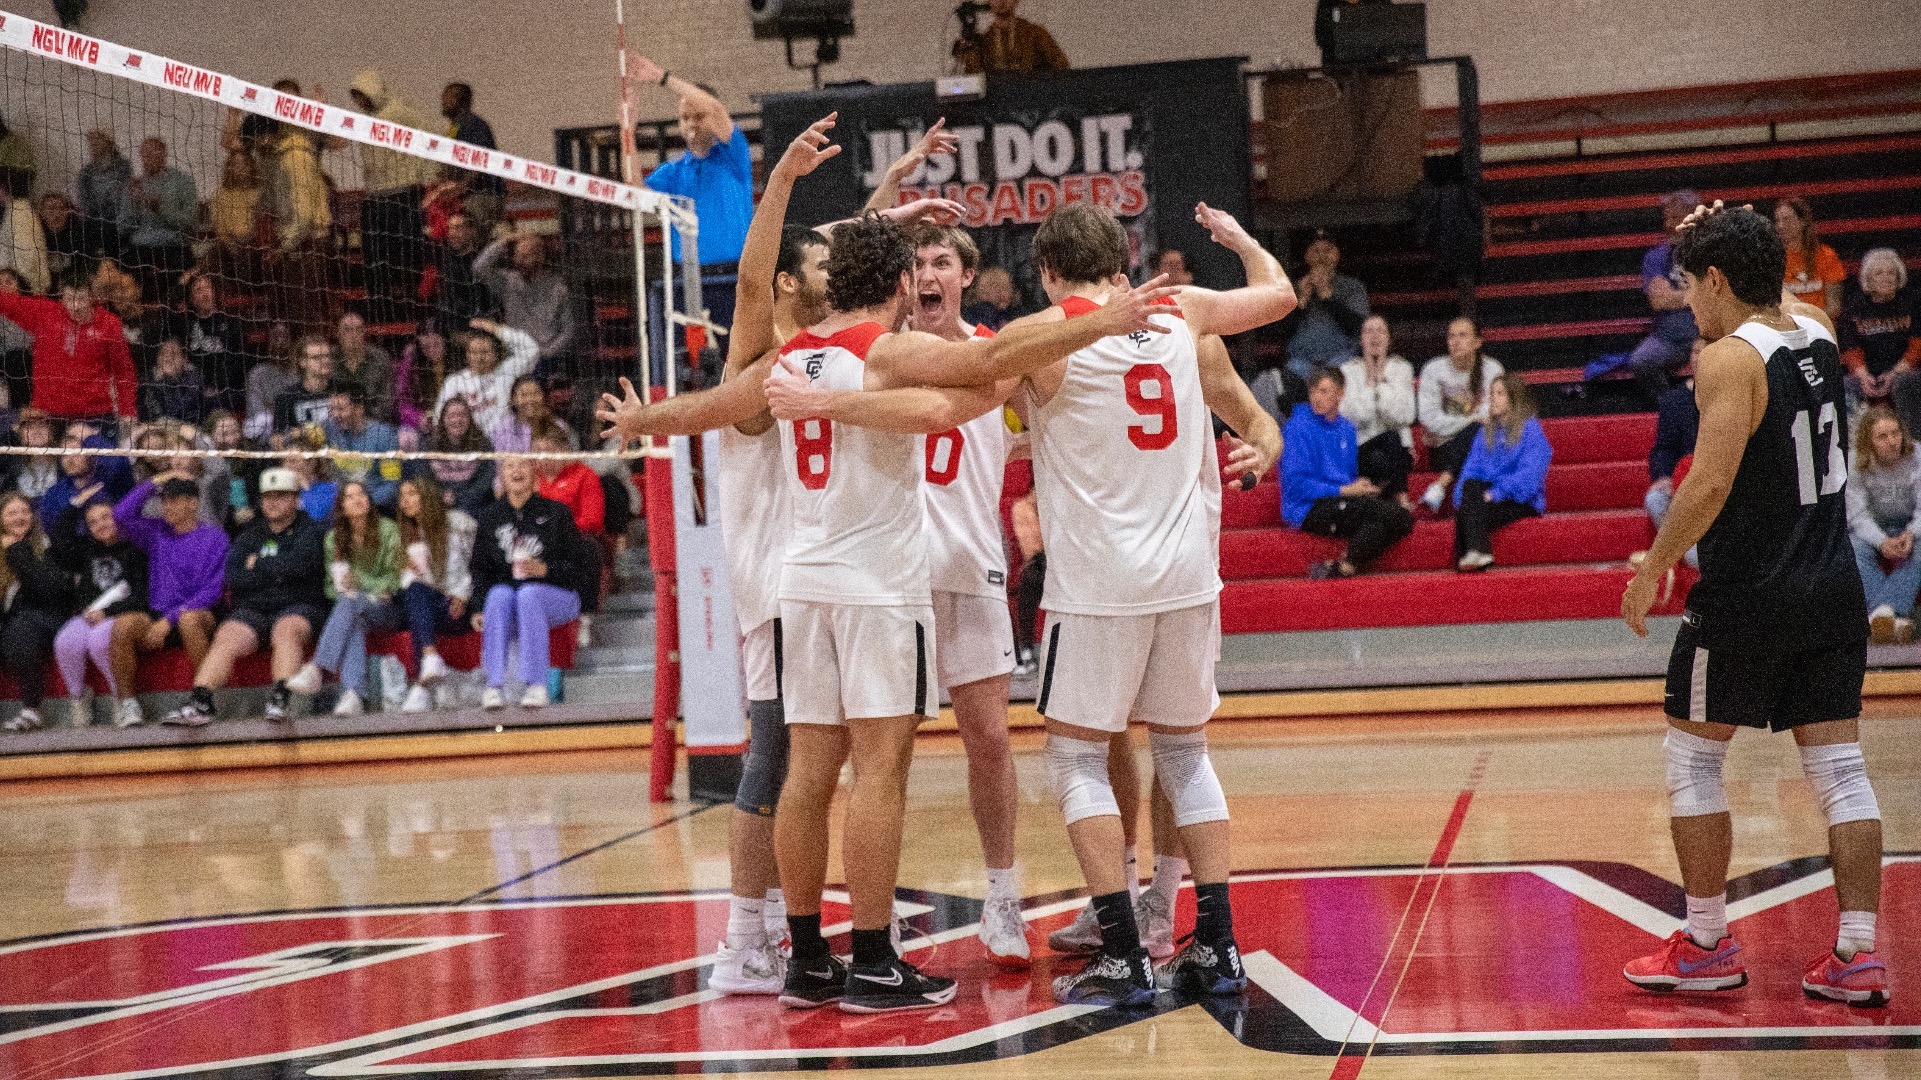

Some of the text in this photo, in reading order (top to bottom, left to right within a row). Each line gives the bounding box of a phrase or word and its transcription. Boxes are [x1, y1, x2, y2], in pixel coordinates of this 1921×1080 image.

[32, 24, 100, 65] NGU MVB
[163, 62, 193, 88] NGU
[274, 95, 300, 119] NGU
[863, 113, 1144, 188] JUST DO IT.
[896, 168, 1149, 229] RUSADERS
[1123, 363, 1178, 451] 9
[793, 417, 832, 490] 8
